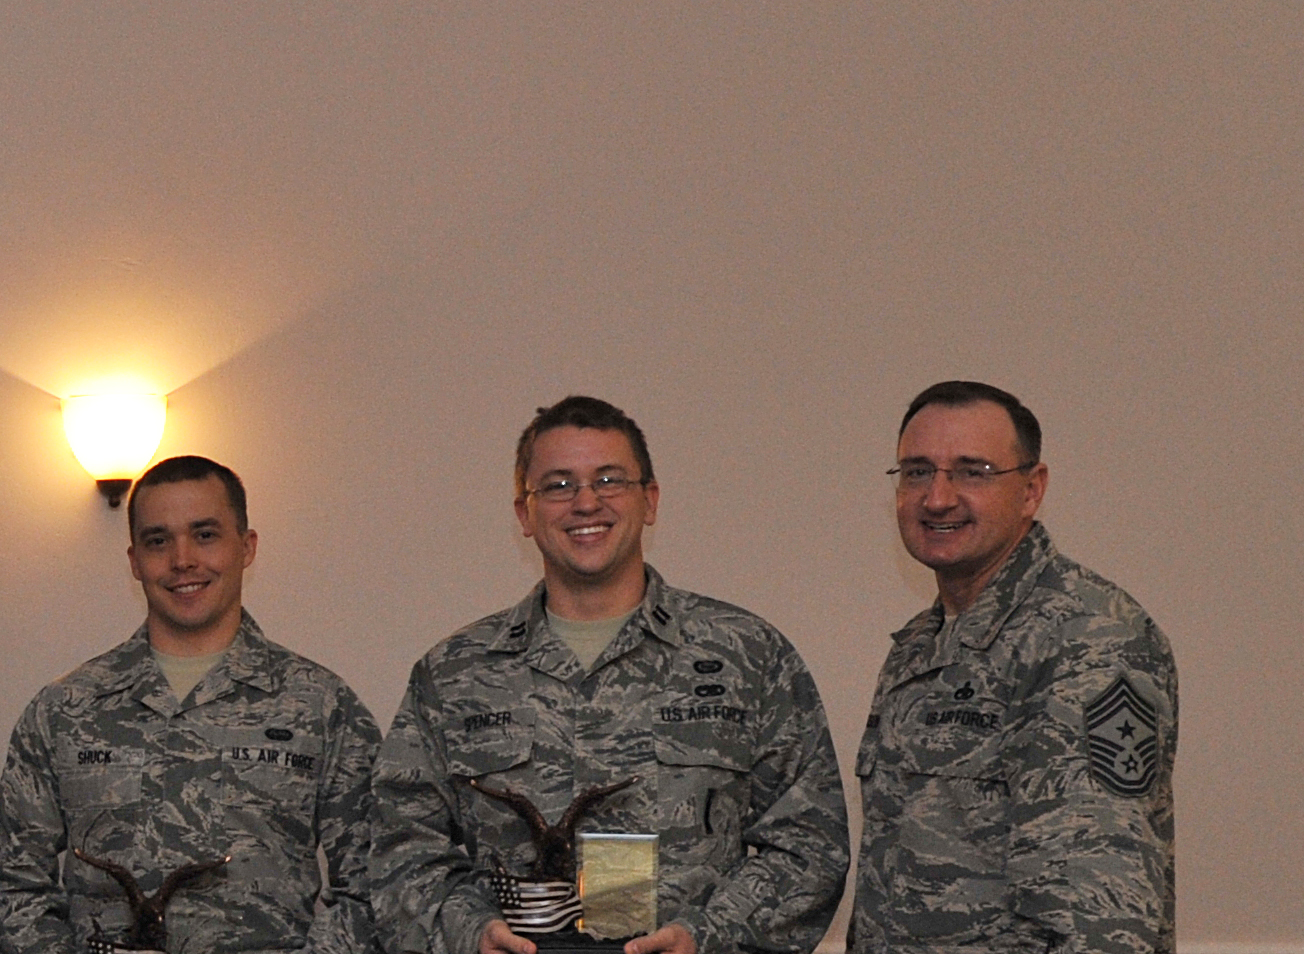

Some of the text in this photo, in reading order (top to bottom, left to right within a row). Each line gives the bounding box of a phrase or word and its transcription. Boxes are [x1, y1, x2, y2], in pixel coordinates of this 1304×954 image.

[464, 711, 511, 732] SPENCER
[688, 706, 711, 720] AIR
[713, 705, 747, 724] FORCE
[954, 709, 1001, 729] FORCE
[77, 750, 112, 765] SHUCK
[232, 747, 315, 770] U.S. AIR FORCE
